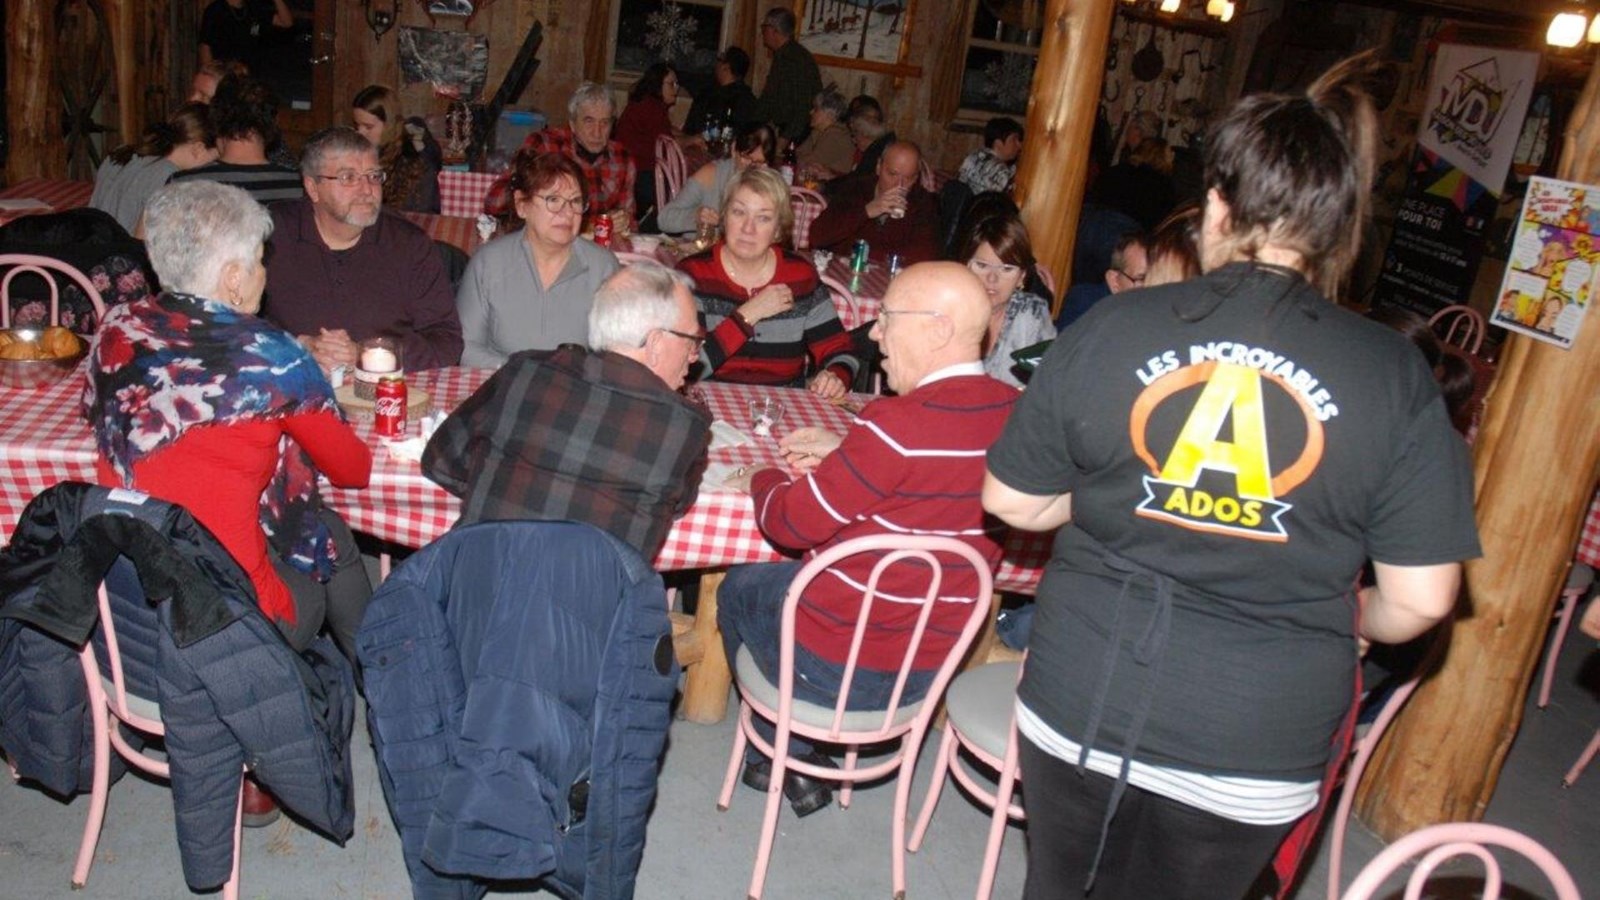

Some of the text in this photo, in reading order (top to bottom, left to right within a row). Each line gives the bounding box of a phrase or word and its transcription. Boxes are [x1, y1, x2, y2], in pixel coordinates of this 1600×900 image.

[1136, 342, 1339, 421] LES INCROYABLES
[1159, 361, 1275, 501] A
[1164, 487, 1262, 526] ADOS
